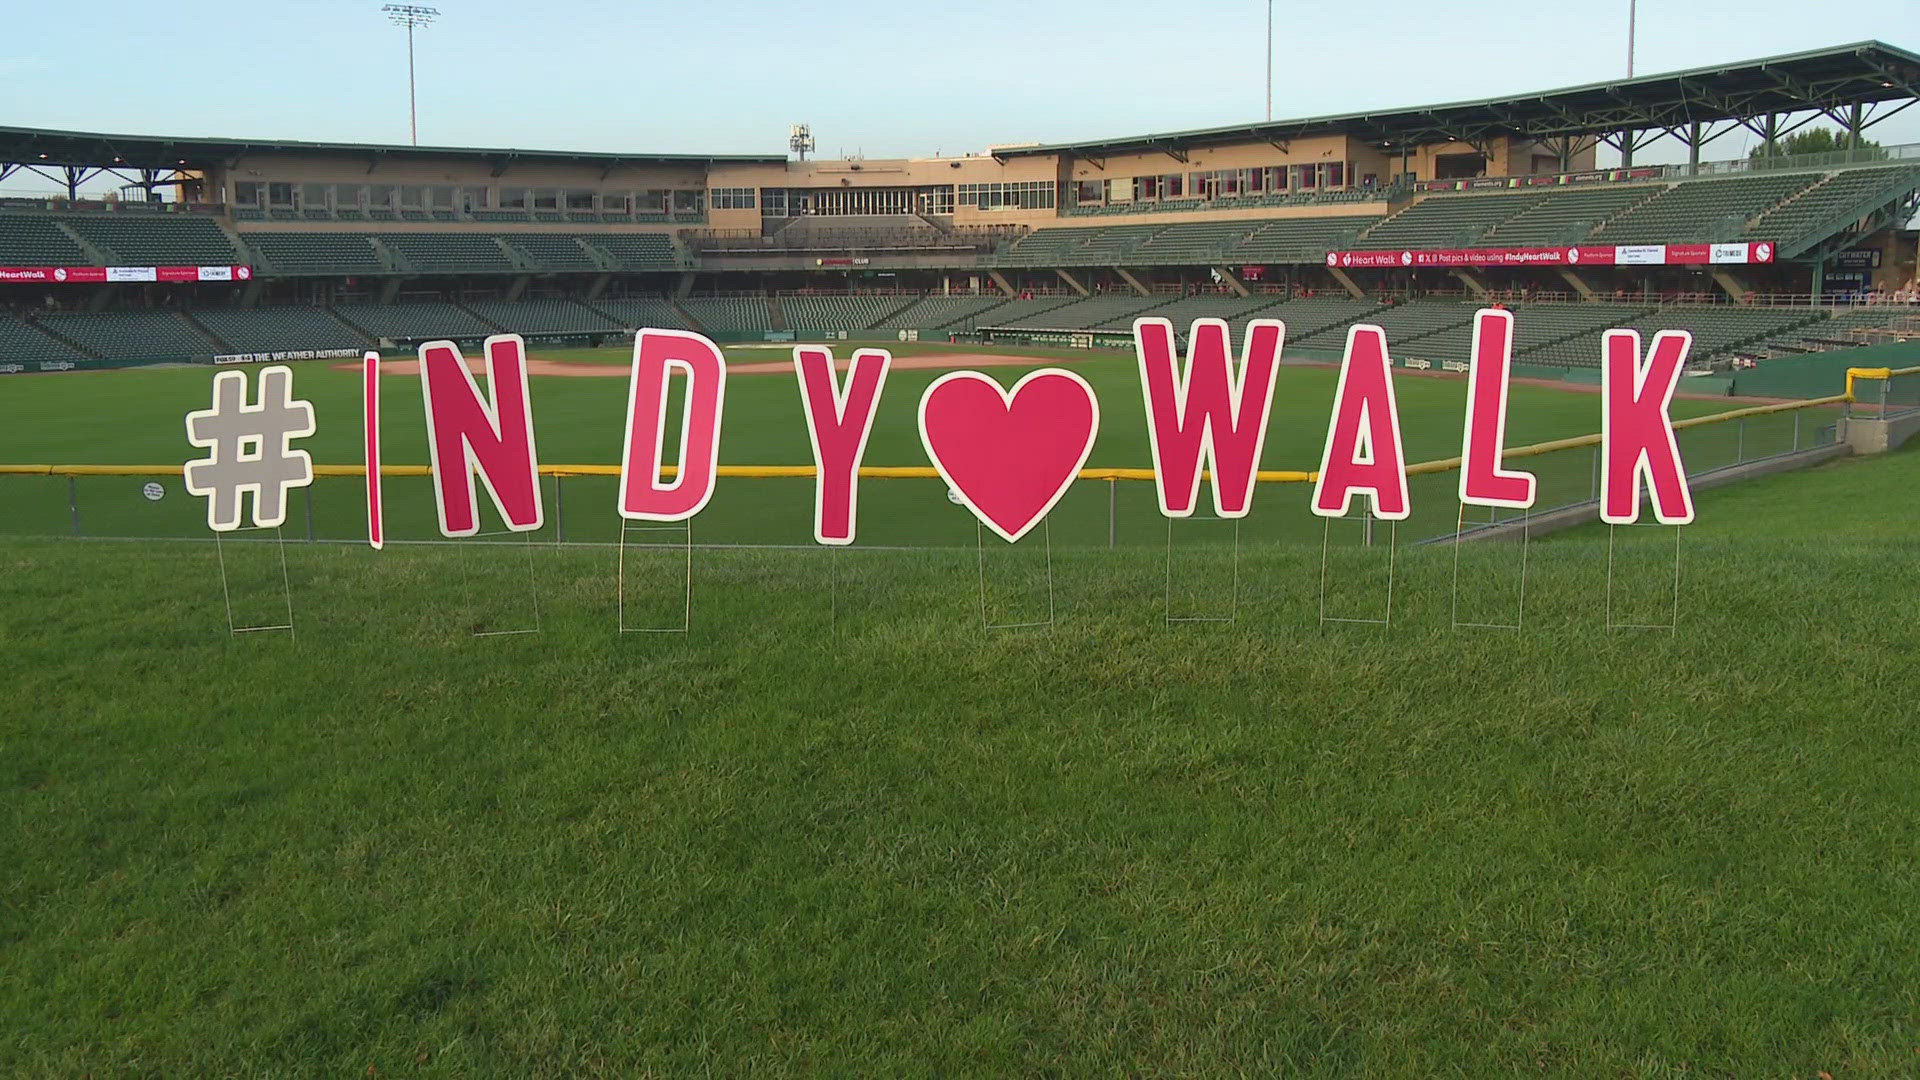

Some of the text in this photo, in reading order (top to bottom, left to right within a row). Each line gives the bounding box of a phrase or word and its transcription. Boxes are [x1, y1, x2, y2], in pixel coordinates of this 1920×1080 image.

[1352, 255, 1396, 265] Heart Walk
[1439, 254, 1451, 262] Post
[1469, 253, 1486, 262] video
[1487, 254, 1503, 264] using
[1505, 251, 1561, 263] #IndyHeartWalk
[254, 353, 269, 362] THE
[271, 350, 315, 361] WEATHER
[315, 348, 360, 359] AUTHORITY
[1132, 307, 1695, 526] WALK
